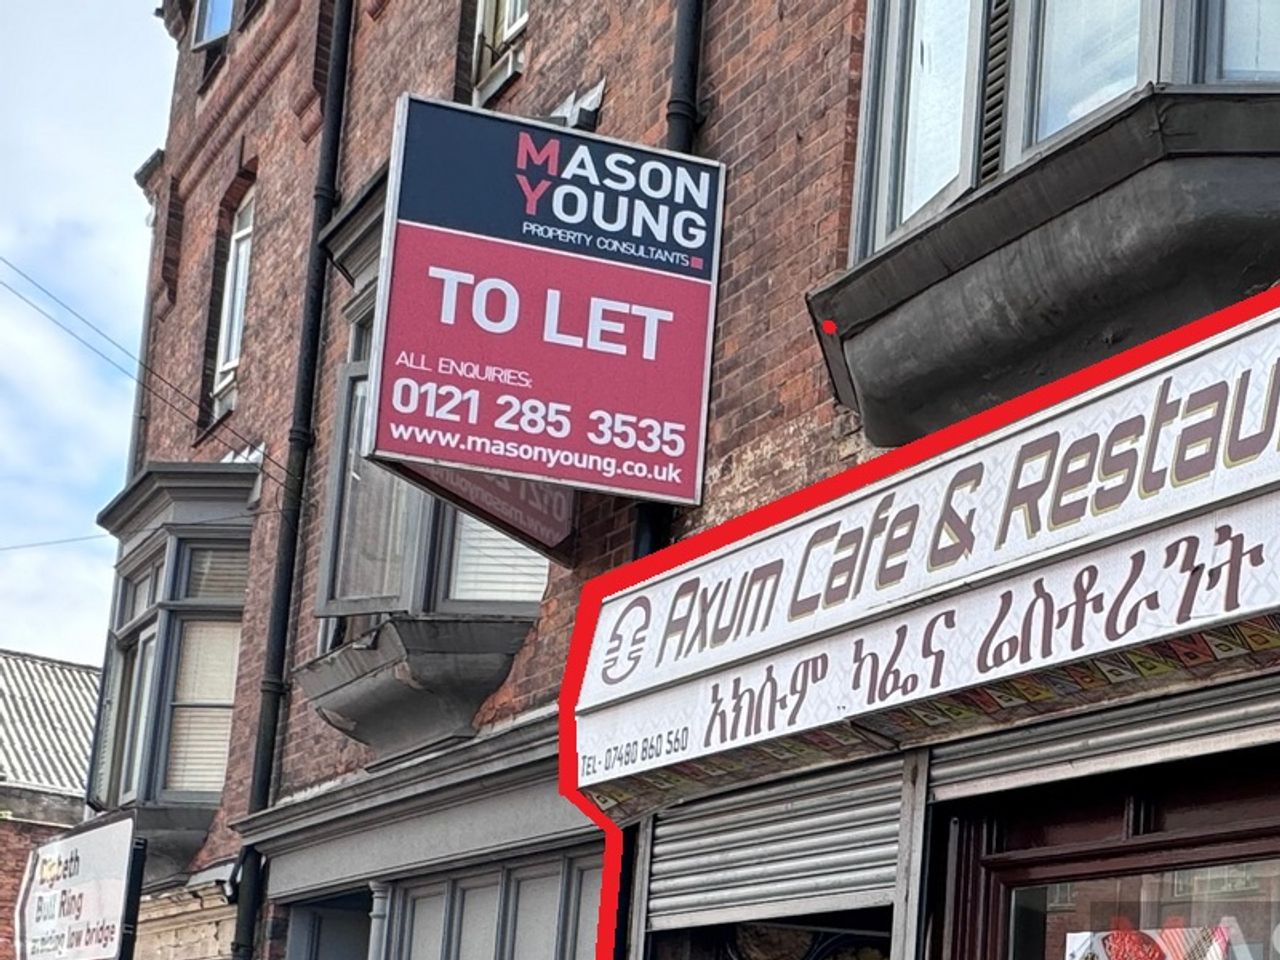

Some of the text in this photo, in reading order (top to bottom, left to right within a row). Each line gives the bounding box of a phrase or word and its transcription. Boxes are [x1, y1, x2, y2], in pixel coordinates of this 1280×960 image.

[515, 131, 711, 210] MASON
[514, 174, 708, 250] YOUNG
[521, 221, 690, 268] PROPERTY CONSULTANTS
[427, 266, 674, 361] TO LET
[395, 350, 533, 389] ALL ENQUIRIES:
[391, 378, 687, 457] 0121 285 3535
[389, 423, 683, 484] www.masonyoung.co.uk
[655, 559, 784, 668] Axum
[787, 492, 921, 622] Cafe
[926, 461, 985, 573] &
[604, 740, 639, 771] 07480
[640, 733, 664, 762] 860
[665, 726, 689, 755] 560
[58, 889, 84, 920] Ring
[66, 925, 83, 949] low
[84, 918, 116, 948] bridge
